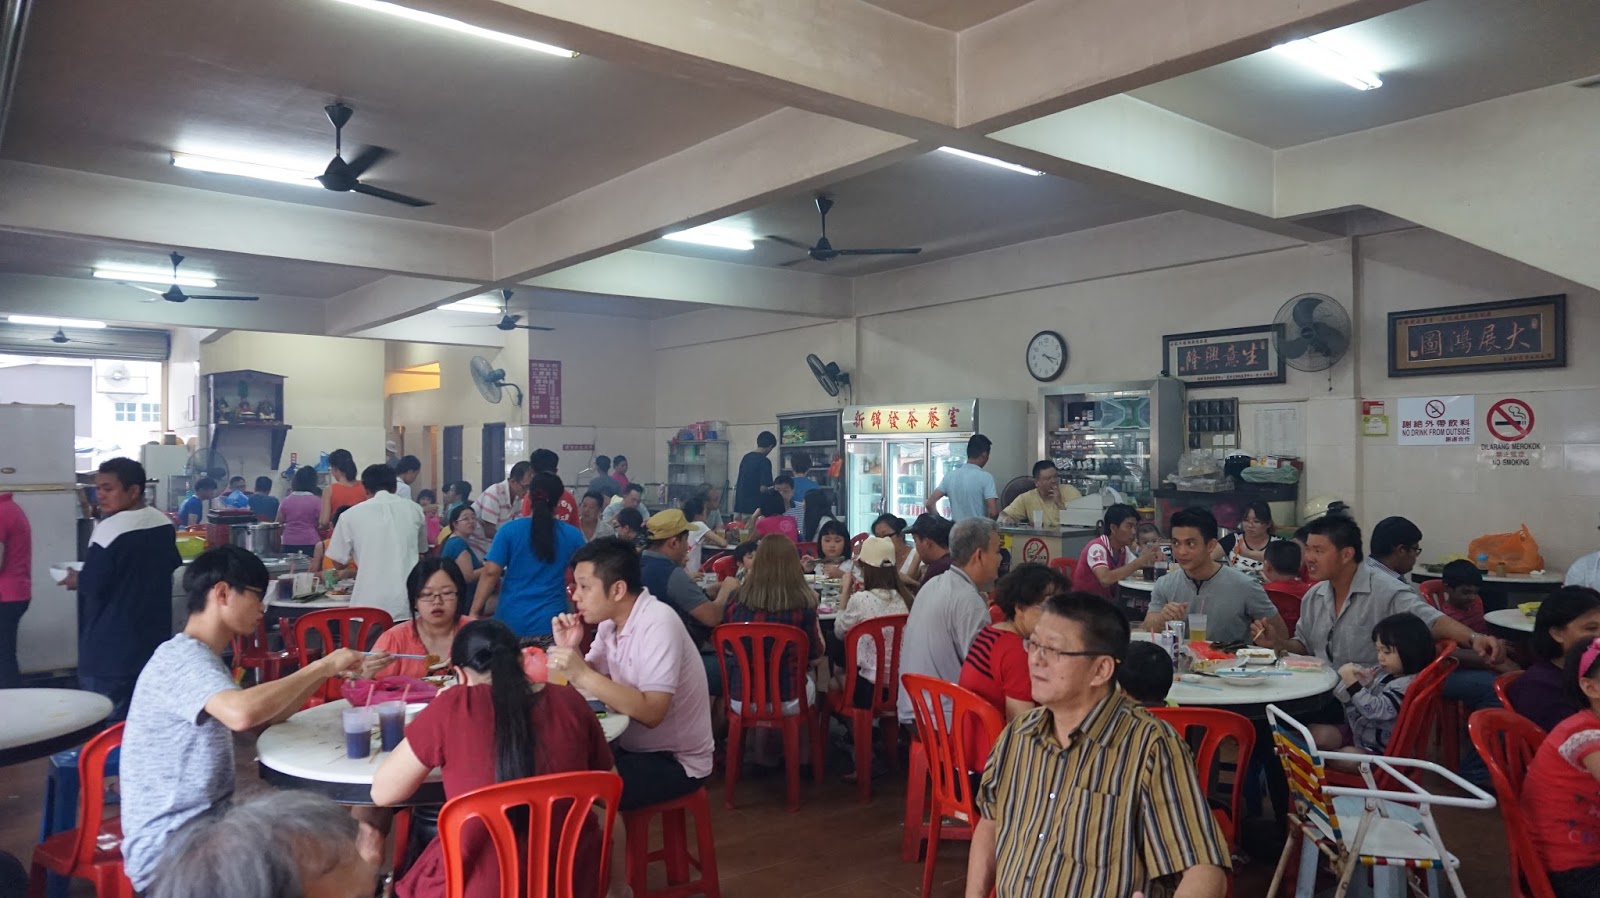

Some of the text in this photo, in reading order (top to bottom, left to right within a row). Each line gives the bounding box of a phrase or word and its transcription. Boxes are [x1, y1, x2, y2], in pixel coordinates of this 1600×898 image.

[1421, 322, 1531, 356] 大展鴻圖
[1186, 342, 1258, 371] 生意興隆
[1411, 428, 1428, 436] DRINK
[1429, 428, 1445, 436] FROM
[1445, 427, 1470, 435] OUTSIDE
[1512, 442, 1541, 450] MEROKOK
[1492, 458, 1530, 466] NO SMOKING
